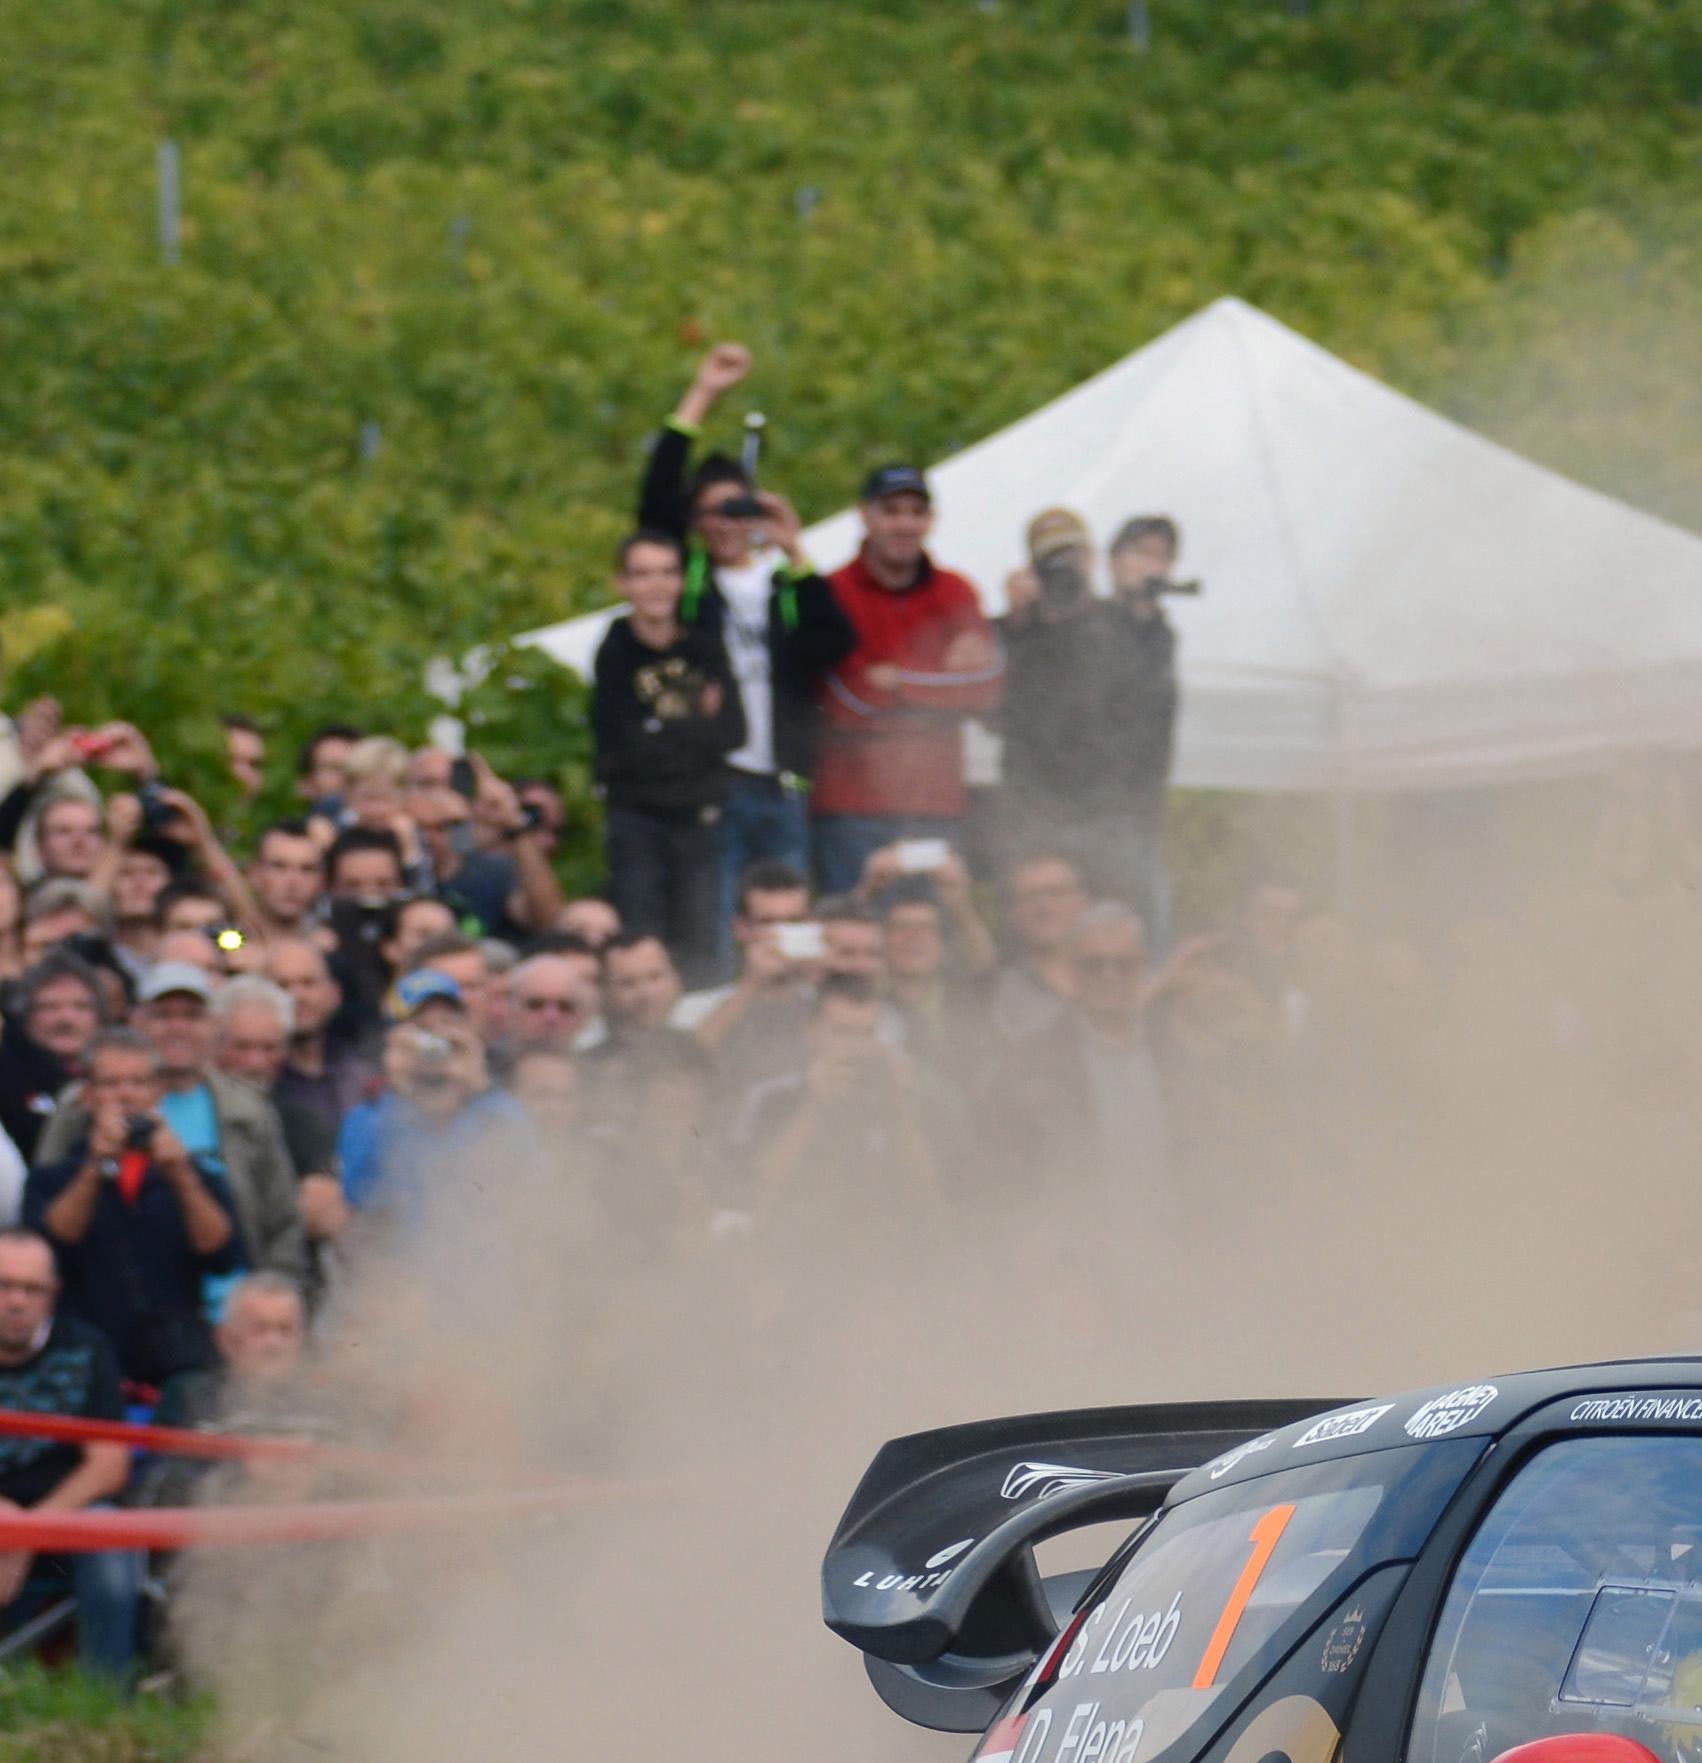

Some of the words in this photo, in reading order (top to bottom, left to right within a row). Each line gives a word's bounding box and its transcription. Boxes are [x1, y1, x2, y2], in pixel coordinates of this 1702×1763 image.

[852, 1569, 953, 1591] LUHTA
[1192, 1504, 1297, 1691] 1
[1058, 1600, 1107, 1680] S.
[1091, 1590, 1184, 1675] Loeb
